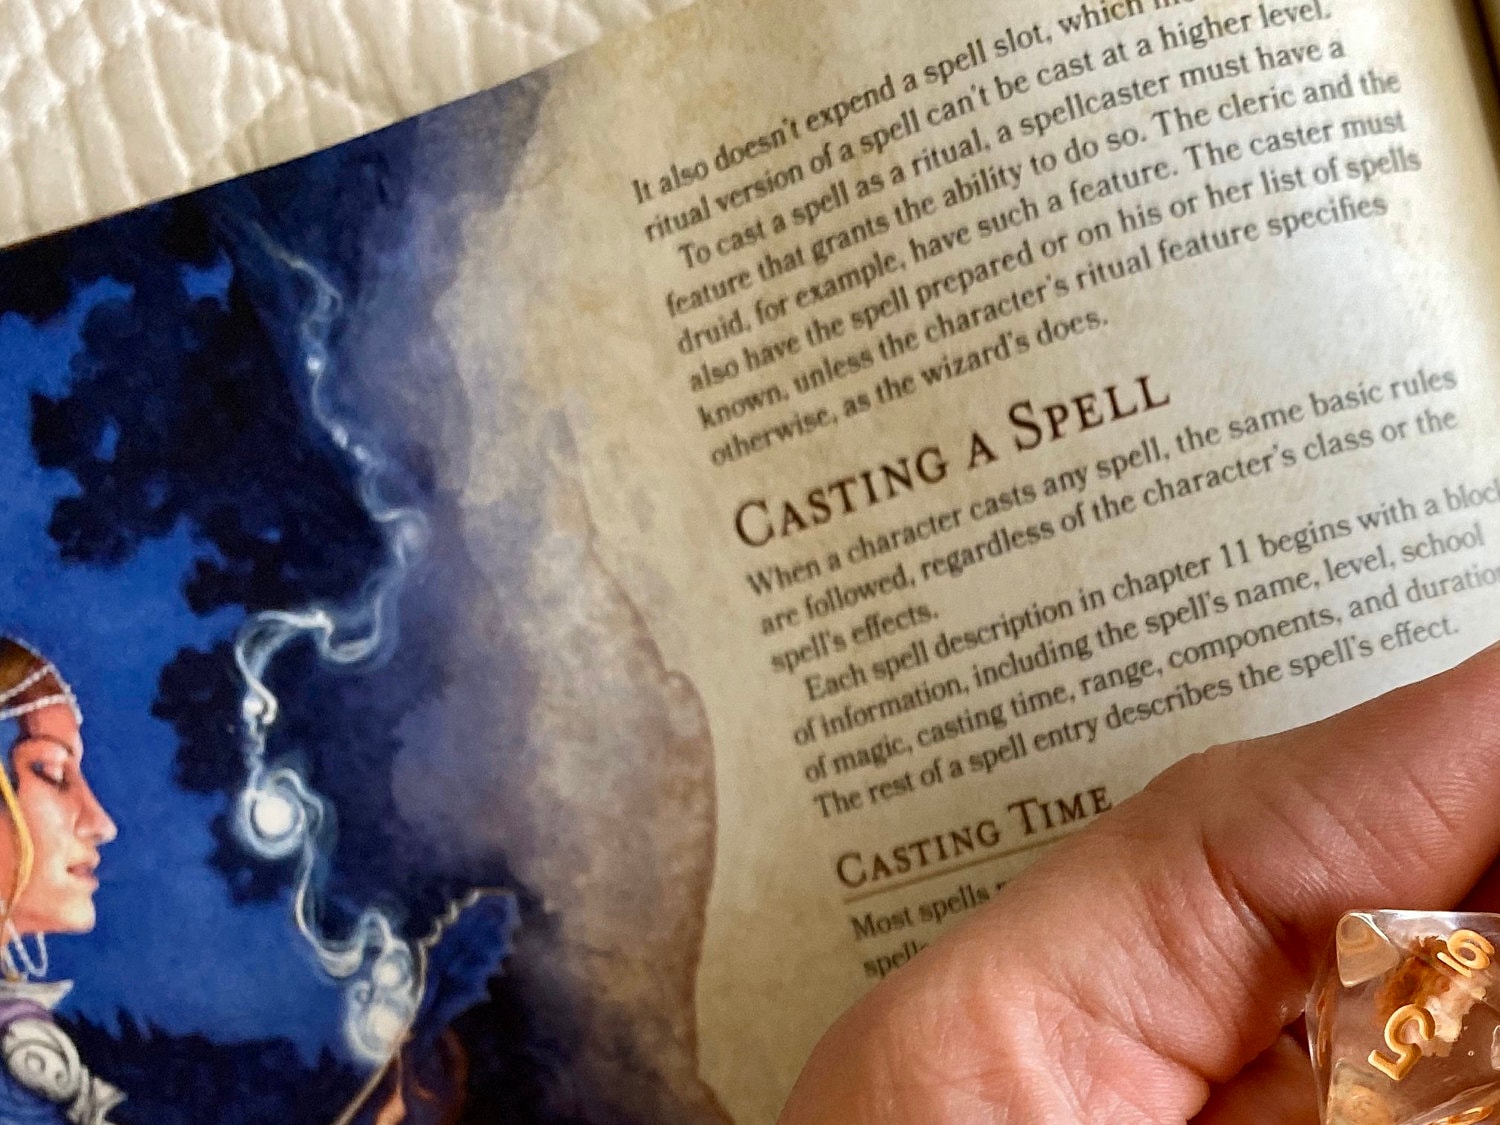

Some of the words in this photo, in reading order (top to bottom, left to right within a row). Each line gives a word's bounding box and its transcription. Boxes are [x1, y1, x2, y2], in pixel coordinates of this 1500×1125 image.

[644, 194, 712, 243] ritual
[714, 164, 804, 212] version
[809, 141, 833, 175] of
[838, 142, 856, 163] a
[859, 107, 921, 155] spell
[993, 74, 1030, 101] be
[1036, 50, 1095, 86] cast
[1101, 41, 1129, 67] at
[1136, 37, 1154, 58] a
[1157, 14, 1252, 51] higher
[792, 348, 875, 394] unless
[877, 331, 919, 361] the
[1075, 243, 1152, 291] ritual
[1157, 222, 1259, 265] feature
[1266, 194, 1388, 239] specifies
[734, 446, 948, 547] CASTING
[967, 431, 998, 470] A
[1008, 375, 1170, 452] SPELL
[745, 559, 822, 596] When
[826, 551, 843, 573] a
[847, 508, 962, 564] character
[969, 484, 1037, 521] casts
[1042, 466, 1088, 497] any
[1175, 425, 1221, 454] the
[1228, 404, 1304, 440] same
[1308, 381, 1383, 417] basic
[1389, 368, 1458, 400] rules
[812, 790, 863, 819] The
[867, 771, 915, 805] rest
[919, 757, 944, 787] of
[948, 759, 965, 779] a
[968, 731, 1028, 775] spell
[1033, 716, 1099, 752] entry
[1104, 679, 1233, 730] describes
[1237, 663, 1283, 691] the
[835, 820, 1001, 889] CASTING
[1006, 786, 1112, 836] TIME
[1368, 1003, 1435, 1081] 5
